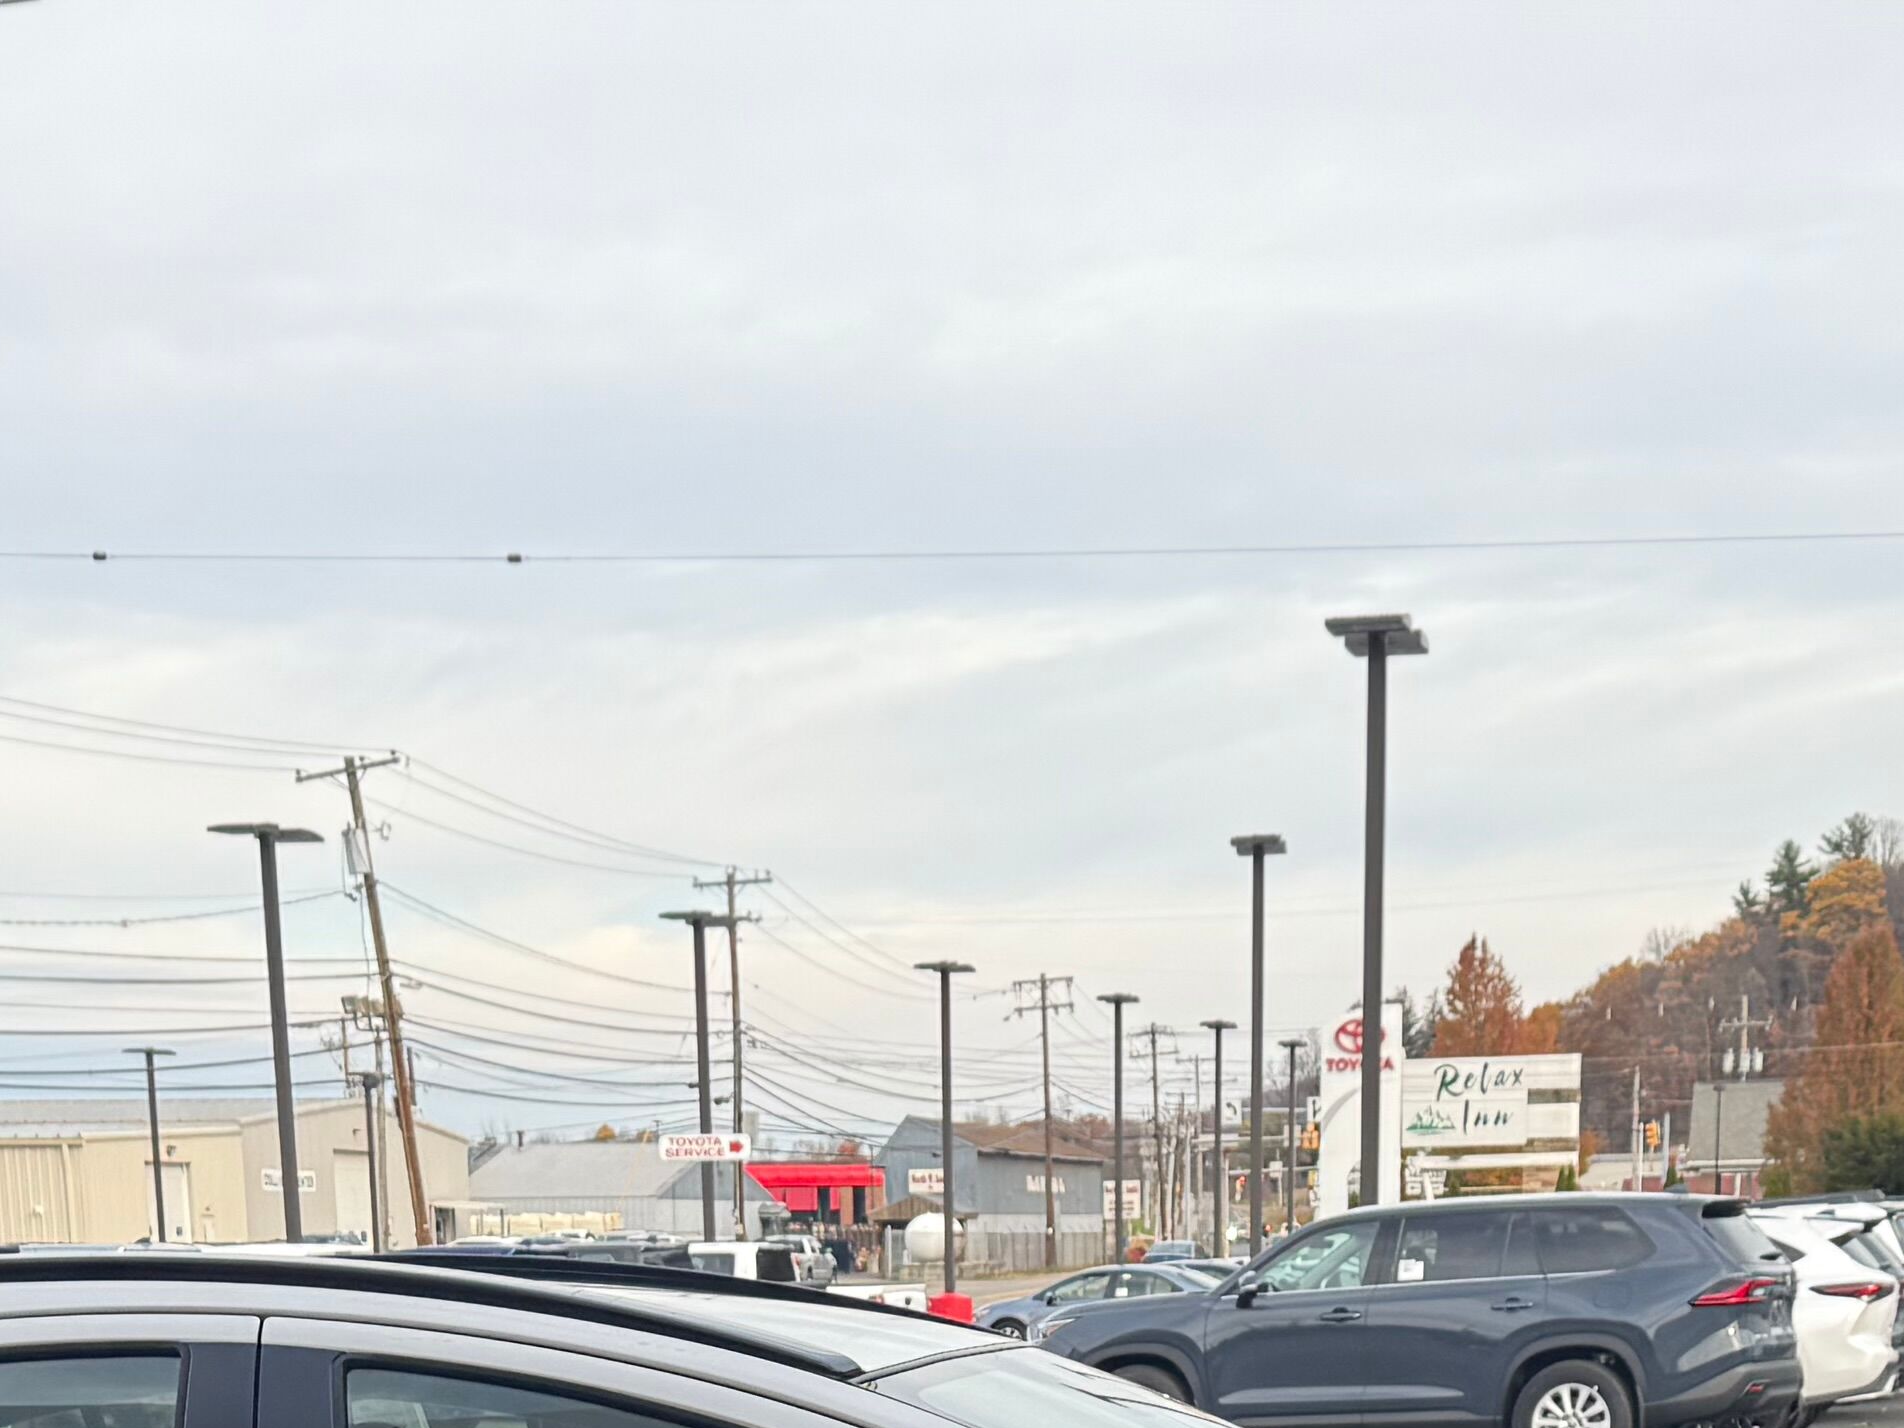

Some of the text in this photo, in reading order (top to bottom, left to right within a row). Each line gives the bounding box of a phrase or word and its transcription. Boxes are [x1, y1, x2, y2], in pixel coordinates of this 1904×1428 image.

[1326, 1057, 1394, 1072] TOYA
[1434, 1062, 1524, 1101] Relax
[1463, 1100, 1514, 1135] Inn
[667, 1136, 722, 1147] TOYOTA
[664, 1147, 725, 1158] SERVICE
